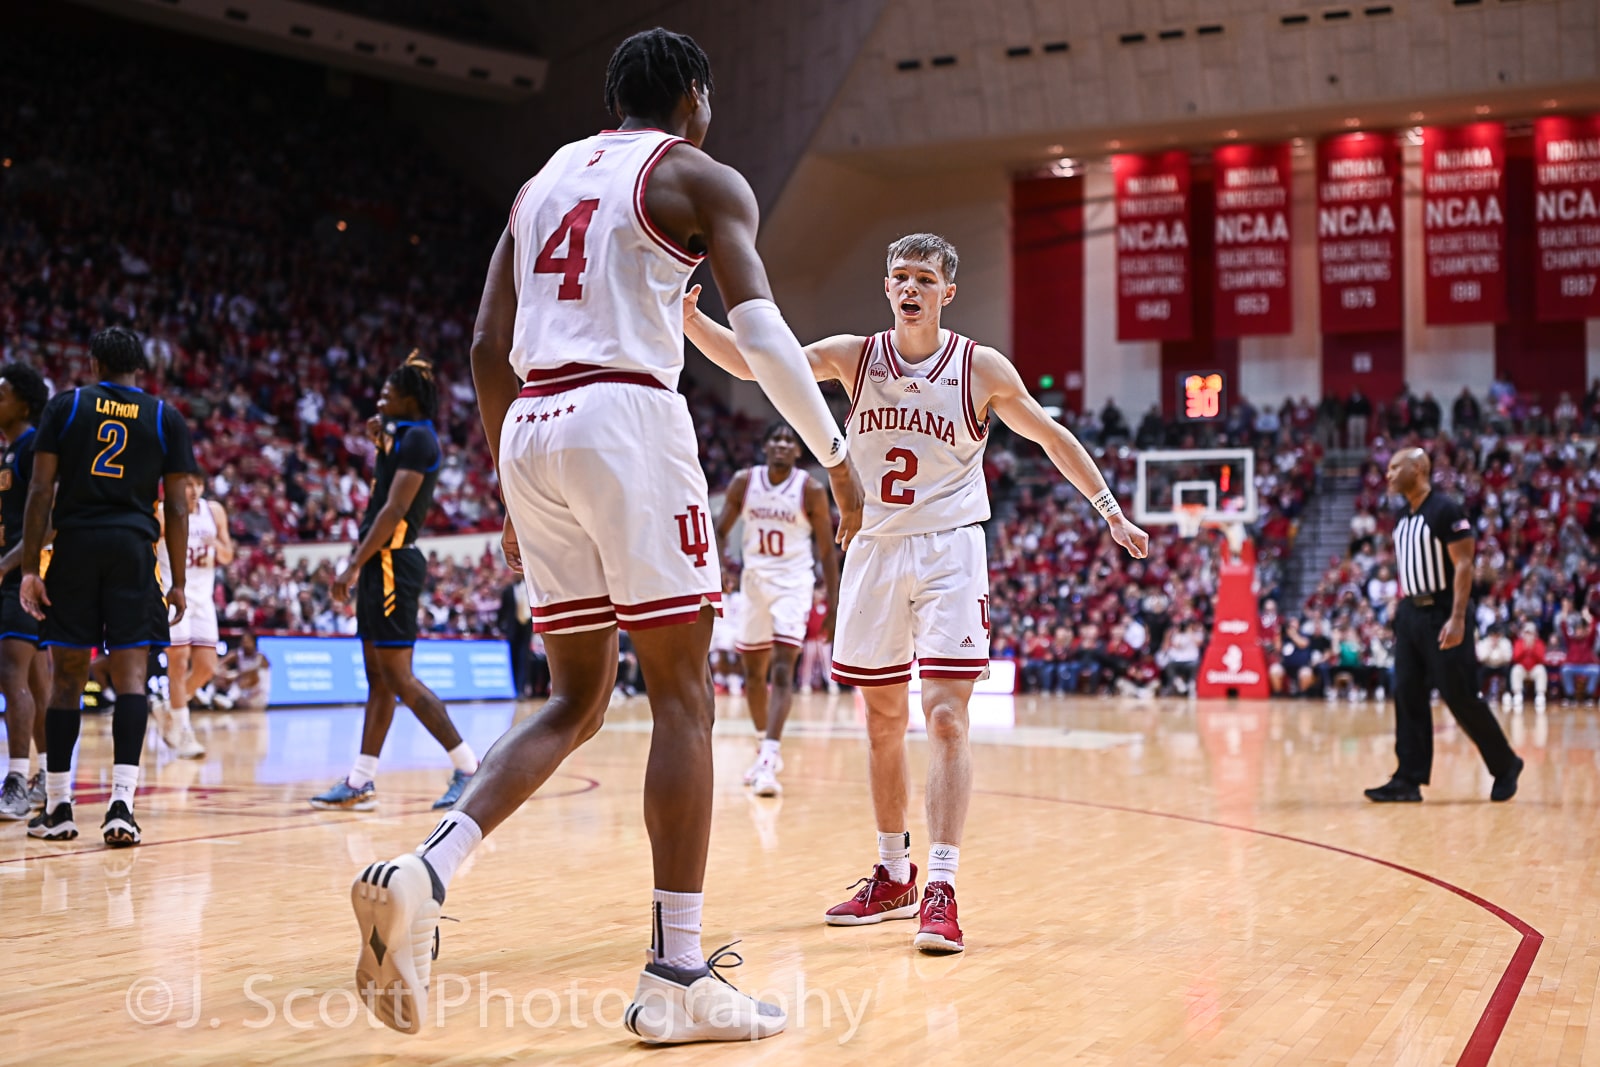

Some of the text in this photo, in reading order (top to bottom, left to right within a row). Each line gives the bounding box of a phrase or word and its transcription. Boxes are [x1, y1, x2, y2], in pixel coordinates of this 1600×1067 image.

[1328, 157, 1385, 179] INDIANA
[1434, 147, 1493, 170] INDIANA
[1125, 174, 1179, 194] INDIANA
[1224, 165, 1279, 187] INDIANA
[1319, 203, 1395, 237] NCAA
[1425, 195, 1502, 229] NCAA
[1536, 188, 1600, 222] NCA
[1118, 220, 1188, 249] NCAA
[1215, 212, 1289, 244] NCAA
[533, 198, 600, 300] 4
[870, 370, 886, 378] RMK
[96, 397, 139, 419] LATHON
[859, 408, 955, 446] INDIANA
[91, 419, 128, 479] 2
[881, 447, 918, 506] 2
[758, 528, 784, 557] 10
